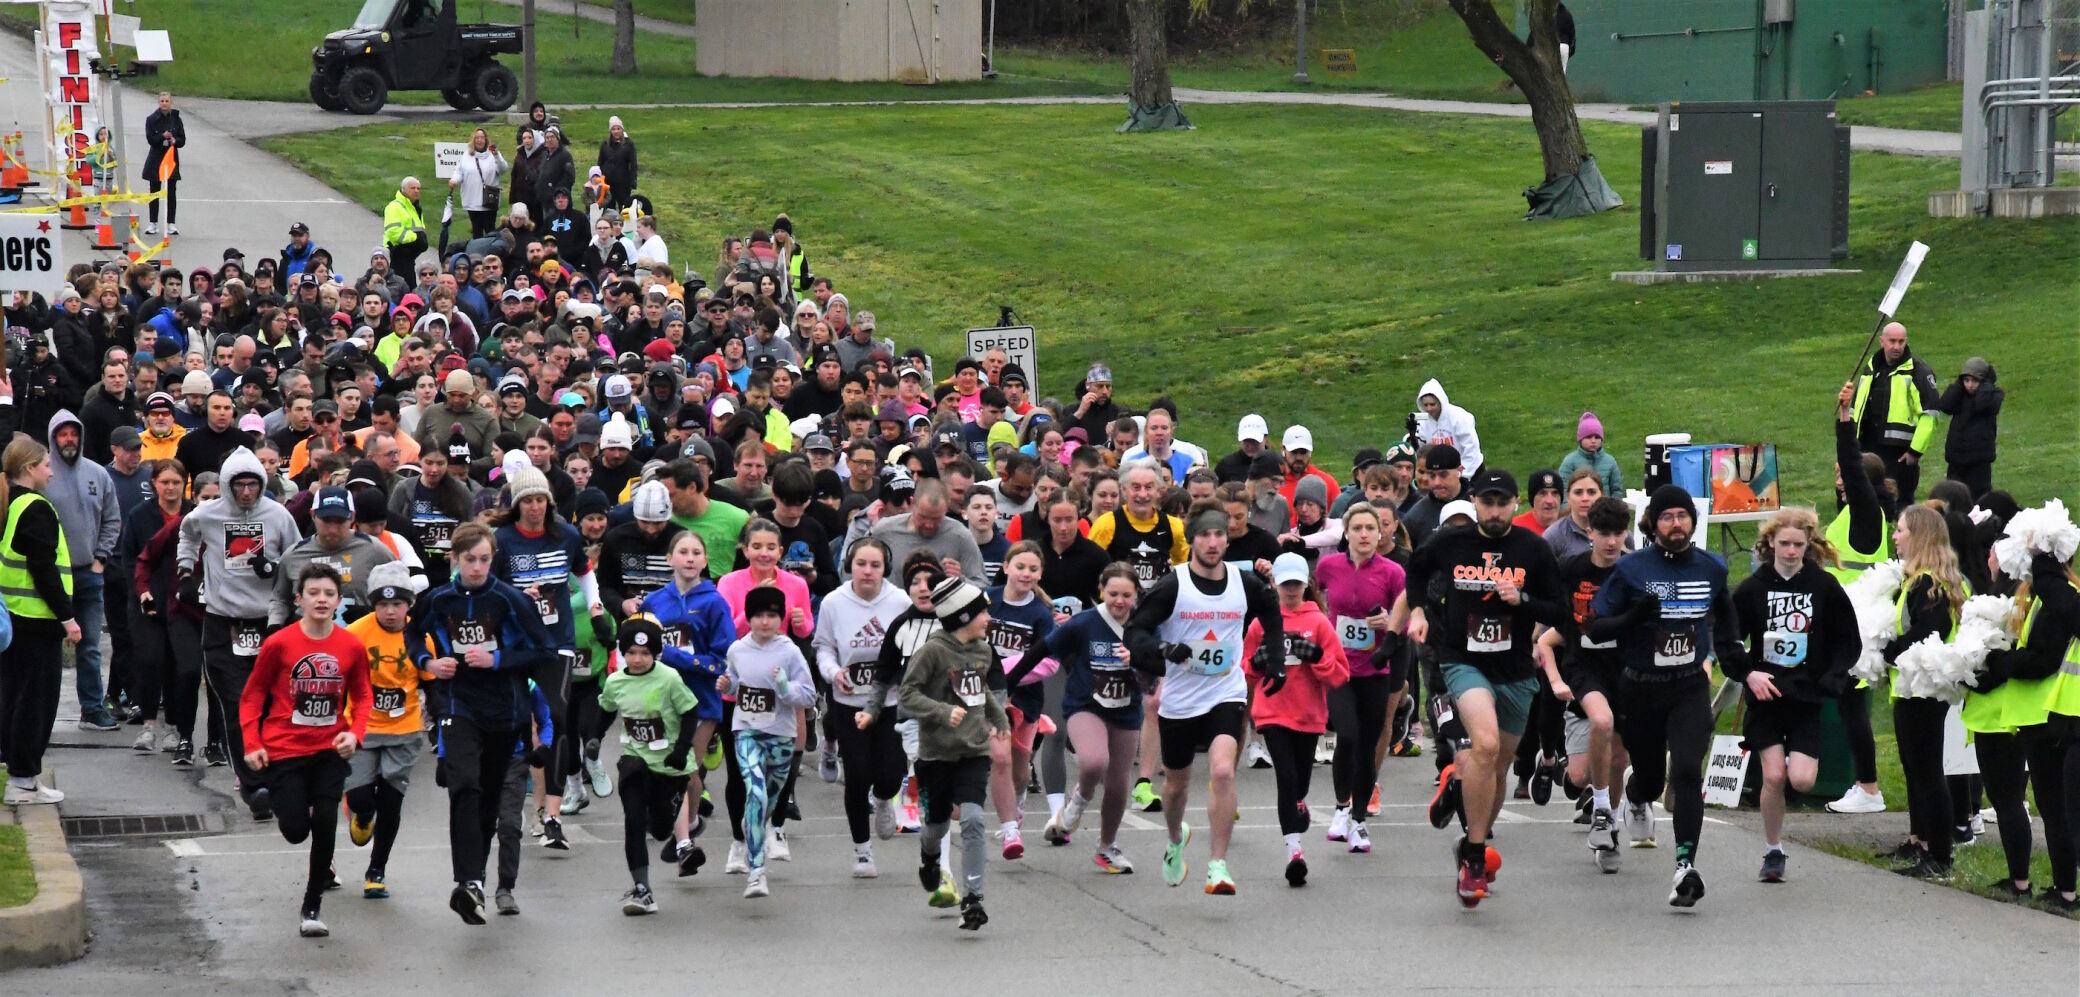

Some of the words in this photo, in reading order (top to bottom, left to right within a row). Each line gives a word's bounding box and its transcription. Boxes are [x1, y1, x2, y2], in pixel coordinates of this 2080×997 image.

[443, 148, 465, 156] Childre
[974, 337, 1029, 352] SPEED
[1453, 565, 1527, 587] COUGAR
[535, 599, 551, 615] 15
[1767, 593, 1813, 618] TRACK
[1180, 611, 1214, 621] DIAMOND
[238, 633, 261, 648] 389
[458, 625, 486, 644] 338
[991, 629, 1022, 650] 1012
[1345, 624, 1368, 641] 85
[1477, 624, 1503, 641] 431
[1664, 637, 1690, 656] 404
[1774, 639, 1798, 657] 62
[1198, 649, 1224, 666] 46
[960, 674, 982, 696] 410
[1102, 682, 1126, 698] 411
[303, 700, 330, 717] 380
[375, 693, 400, 710] 382
[742, 694, 766, 712] 545
[632, 725, 656, 741] 381
[1726, 755, 1744, 770] Race
